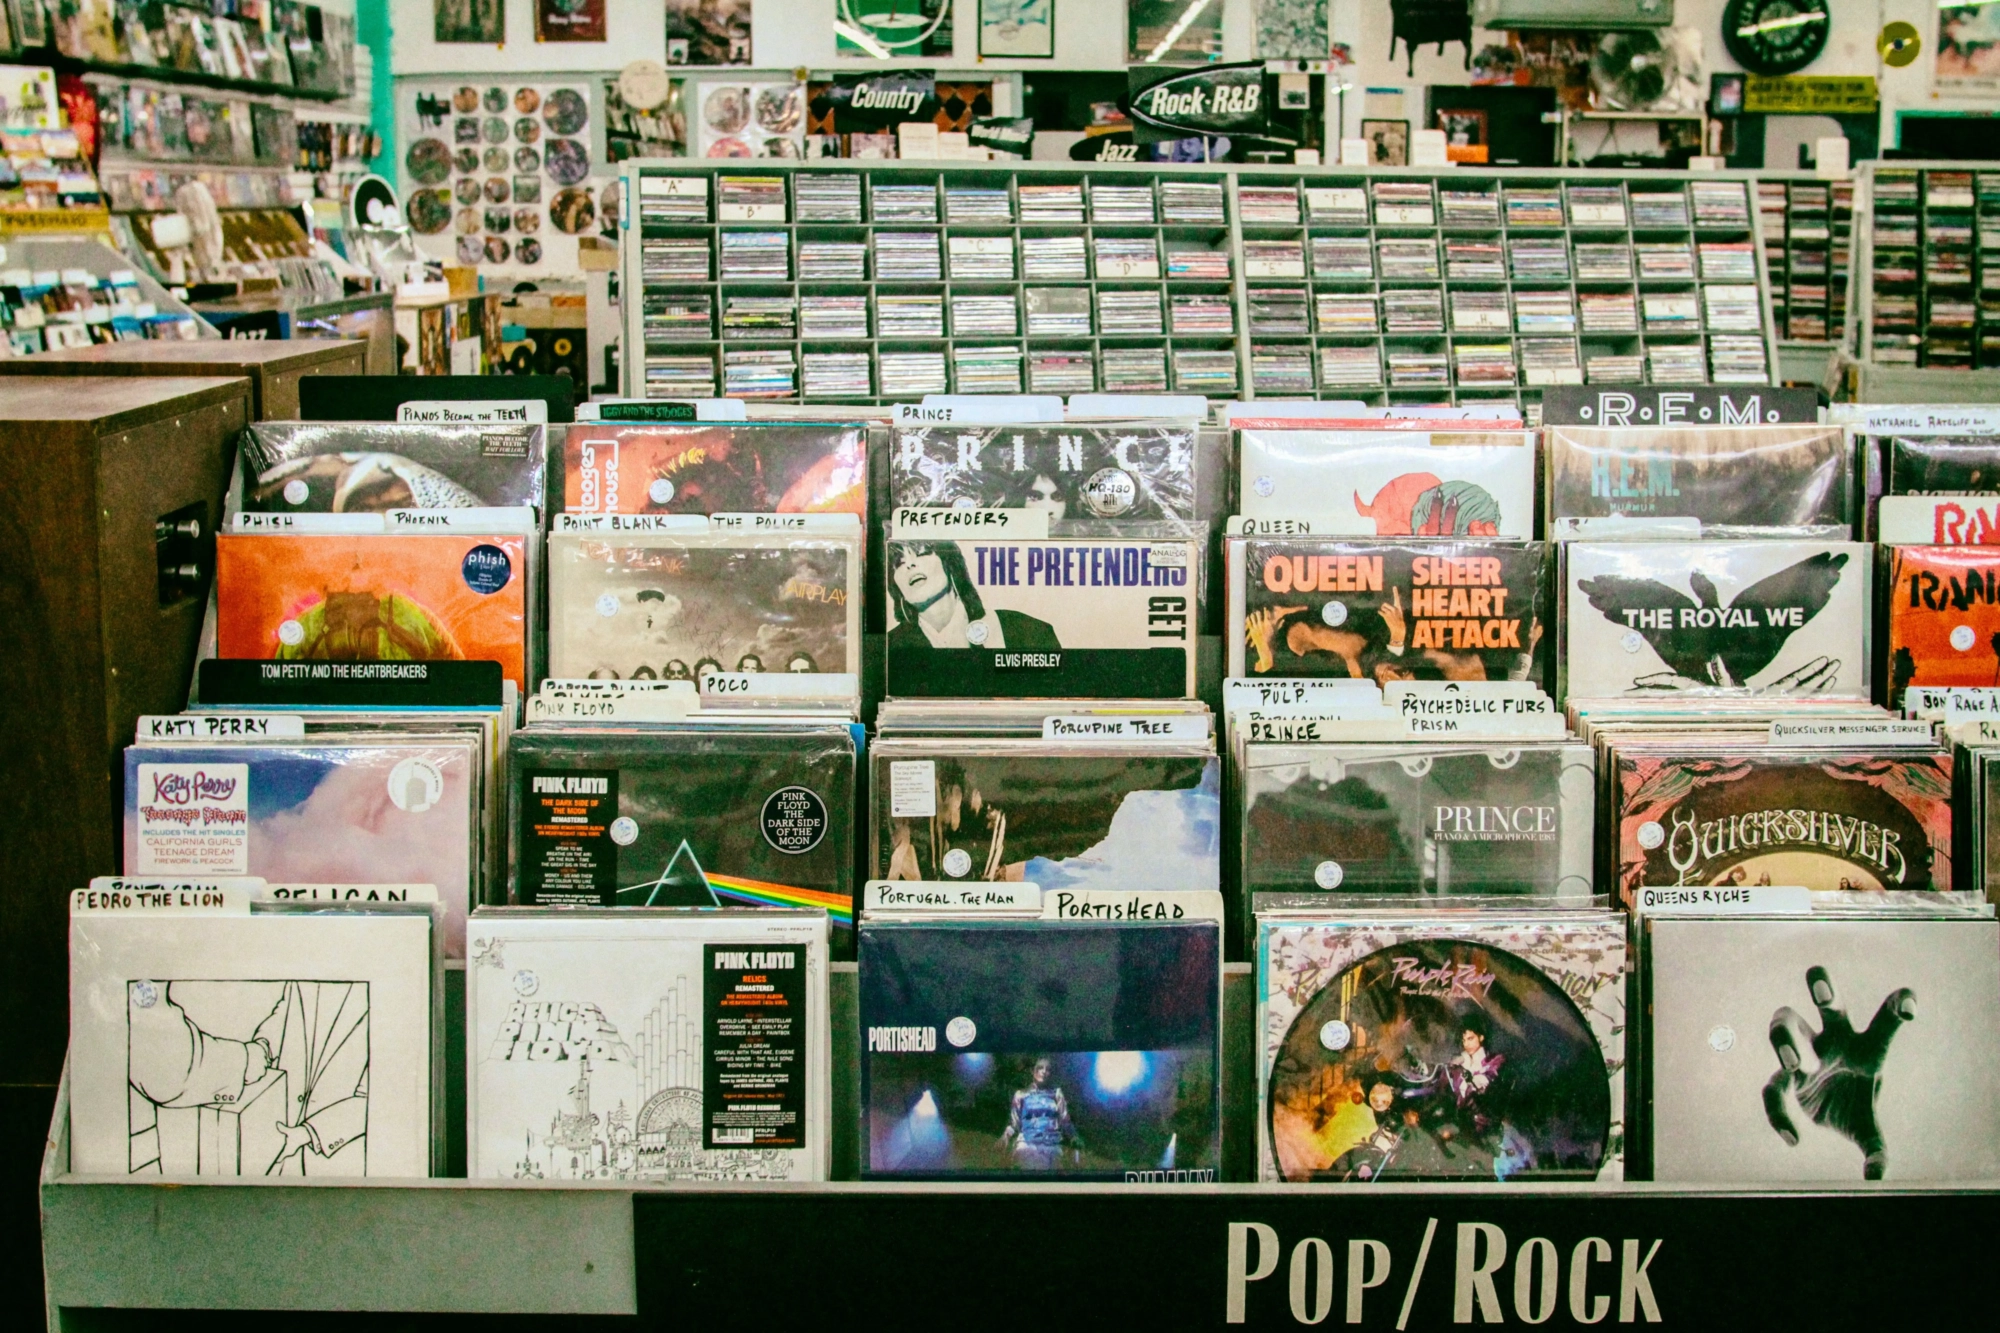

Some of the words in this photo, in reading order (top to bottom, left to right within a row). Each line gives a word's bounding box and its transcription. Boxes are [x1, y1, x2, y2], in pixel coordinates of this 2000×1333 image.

[851, 82, 925, 114] Country
[1096, 139, 1139, 162] Jazz
[403, 407, 440, 422] PIANOS
[443, 408, 476, 421] BECOME
[477, 412, 491, 421] THE
[494, 405, 527, 421] TEETH
[603, 407, 622, 417] IGGY
[623, 407, 639, 417] AND
[640, 406, 654, 416] THE
[656, 406, 693, 417] STOOGES
[902, 406, 952, 421] PRINCE
[900, 435, 1192, 472] PRINCE
[565, 440, 600, 514] tooges
[1590, 447, 1680, 497] R.E.M.
[1089, 483, 1131, 494] HQ-180
[395, 512, 451, 526] PHOENIX
[563, 517, 602, 530] POINT
[612, 516, 667, 530] BLANK
[714, 516, 743, 528] THE
[756, 517, 806, 528] POLICE
[901, 509, 1008, 527] PRETENDERS
[1242, 518, 1310, 535] QUEEN
[468, 550, 506, 566] phish
[975, 547, 1020, 585] THE
[1263, 555, 1383, 593] QUEEN
[1412, 557, 1502, 586] SHEER
[786, 579, 850, 606] AIRPLAY
[1412, 588, 1508, 617] HEART
[1148, 596, 1187, 640] GET
[1622, 609, 1673, 629] THE
[1680, 608, 1759, 629] ROYAL
[1765, 607, 1804, 627] WE
[1412, 619, 1521, 648] ATTACK
[995, 654, 1020, 667] ELVIS
[1022, 654, 1061, 667] PRESLEY
[261, 665, 281, 678] TOM
[282, 665, 311, 678] PETTY
[312, 665, 331, 678] AND
[332, 665, 350, 678] THE
[350, 665, 427, 679] HEARTBREAKERS
[707, 676, 749, 693] POCO
[1261, 688, 1308, 706] PULP.
[1952, 695, 1985, 711] RAGE
[535, 700, 564, 716] PINK
[573, 702, 615, 715] FLOYD
[1402, 697, 1497, 716] PSYCHEDELIC
[1502, 698, 1546, 714] FURS
[152, 719, 195, 736] KATY
[205, 718, 268, 735] PERRY
[1053, 719, 1123, 734] PORCUPINE
[1130, 720, 1173, 734] TREE
[1250, 722, 1321, 740] PRINCE
[1412, 718, 1458, 733] PRISM
[1774, 724, 1835, 736] QUICKSILVER
[1839, 725, 1888, 735] MESSENGER
[153, 771, 190, 805] Katy
[192, 770, 237, 801] Perry
[533, 776, 566, 793] PINK
[566, 777, 608, 794] FLOYD
[777, 801, 810, 809] FLOYD
[141, 806, 201, 827] Teenage
[203, 807, 247, 826] Dream
[784, 810, 804, 818] THE
[1434, 805, 1555, 832] PRINCE
[768, 819, 795, 827] DARK
[776, 828, 790, 836] OF
[792, 828, 812, 836] THE
[146, 838, 205, 846] CALIFORNIA
[207, 838, 242, 846] GURLS
[779, 837, 810, 845] MOON
[1667, 806, 1907, 886] QUICKSILVER
[154, 848, 198, 856] TEENAGE
[200, 848, 235, 856] DREAM
[77, 892, 131, 909] PEDRO
[137, 893, 172, 908] THE
[180, 892, 224, 908] LION
[878, 885, 956, 904] PORTUGAL.
[960, 892, 981, 905] THE
[985, 892, 1014, 904] MAN
[1645, 890, 1698, 906] QUEENS
[1704, 890, 1750, 903] RYCHE
[1057, 893, 1185, 919] PORTISHEAD
[715, 952, 750, 969] PINK
[751, 952, 795, 969] FLOYD
[743, 975, 767, 983] RELICS
[1391, 957, 1453, 996] Purple
[1452, 964, 1497, 1005] Rain
[869, 1026, 936, 1051] PORTISHEAD
[1226, 1217, 1663, 1332] POP/ROCK
